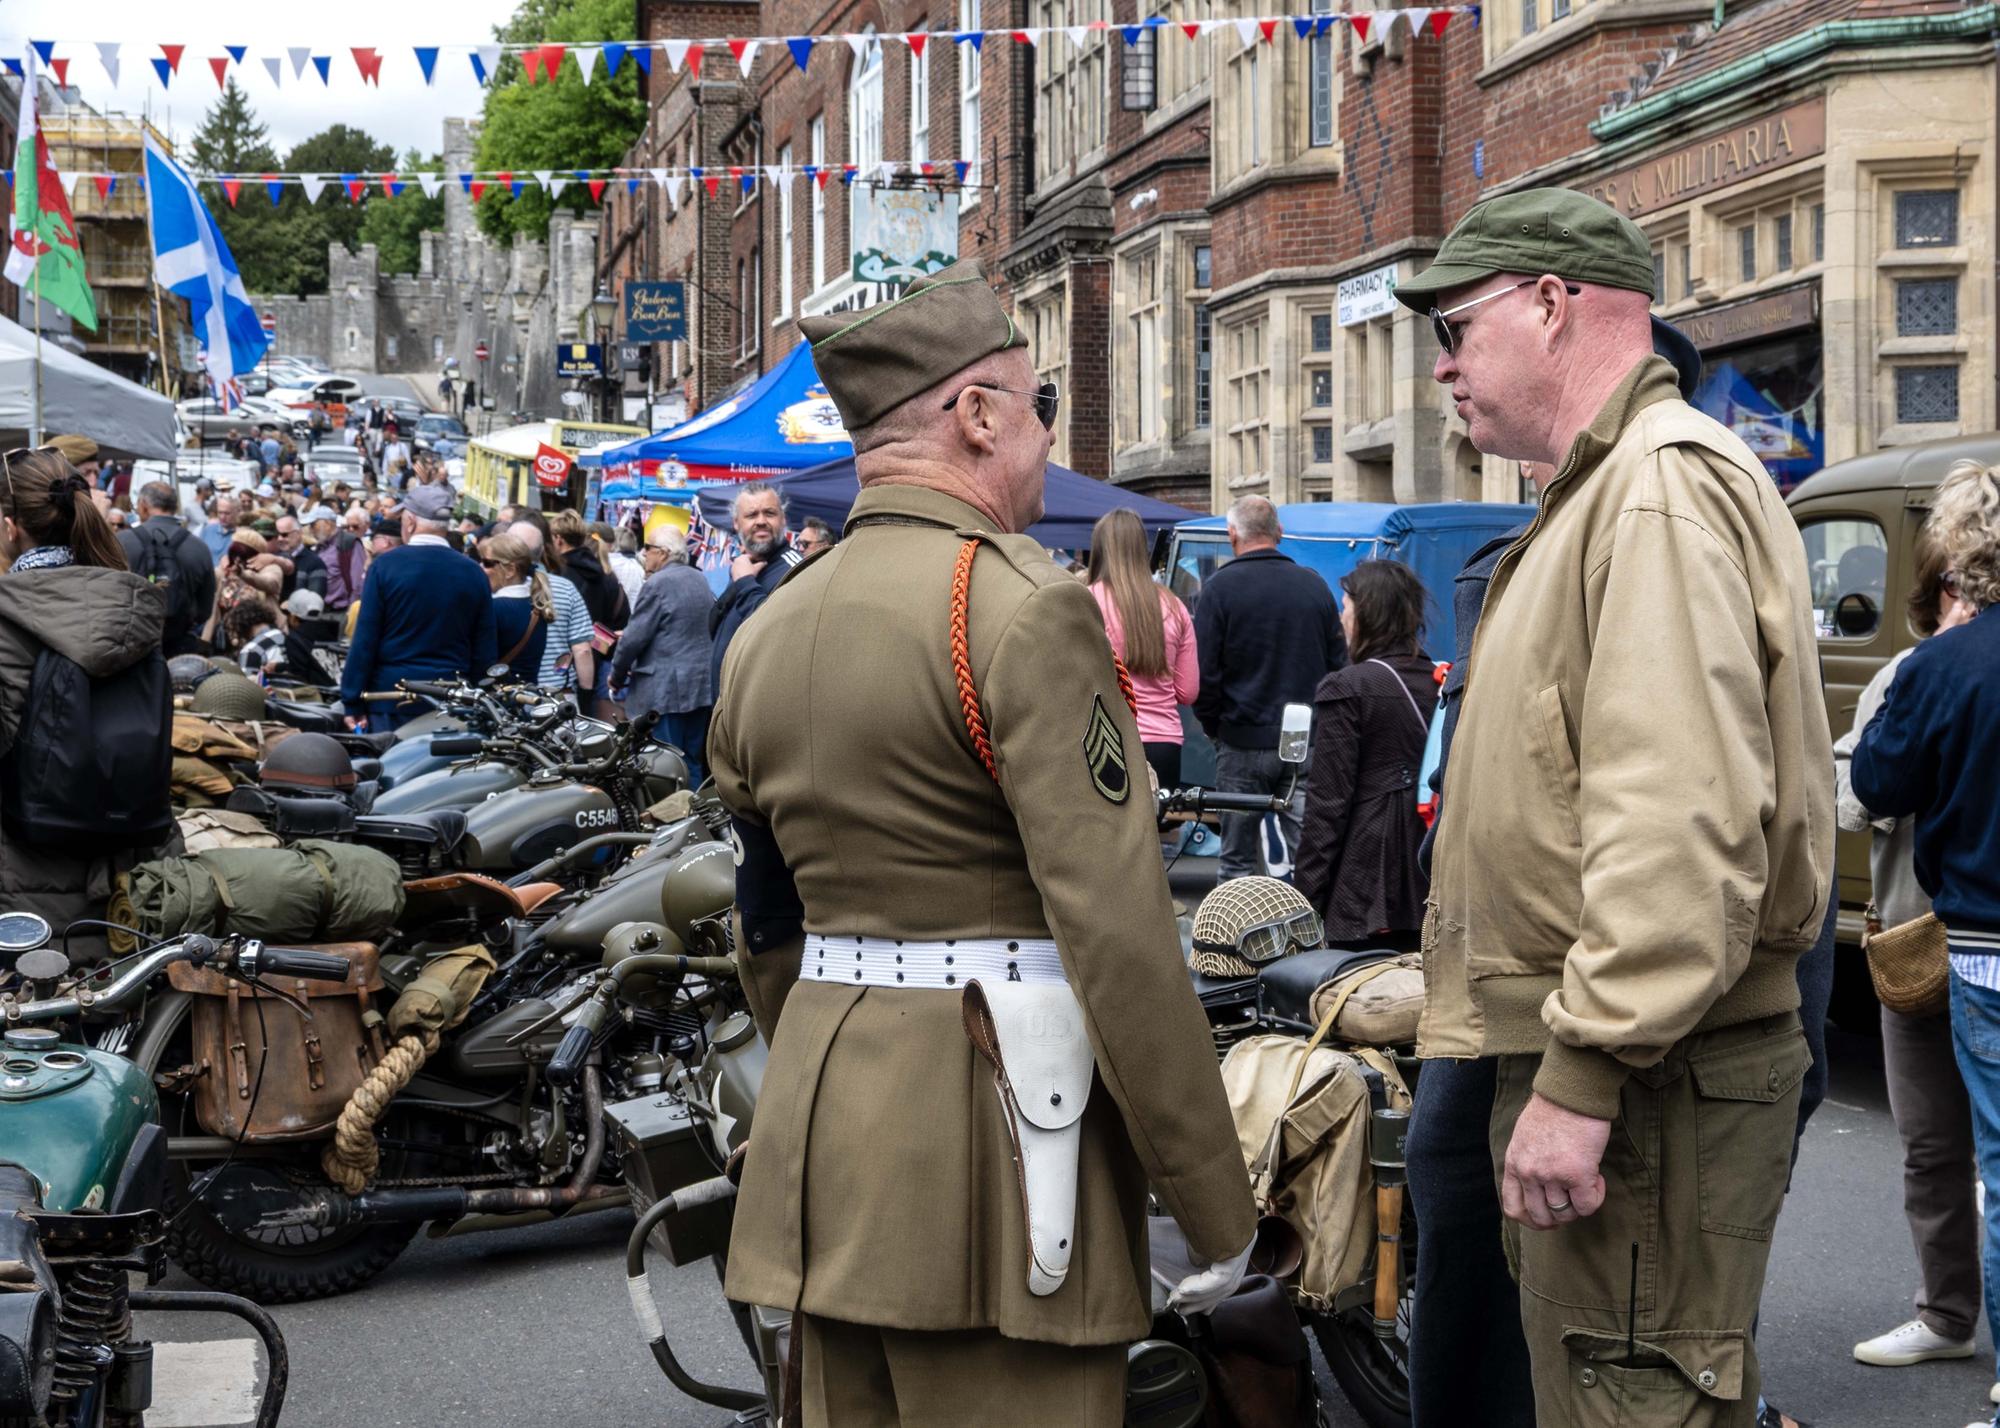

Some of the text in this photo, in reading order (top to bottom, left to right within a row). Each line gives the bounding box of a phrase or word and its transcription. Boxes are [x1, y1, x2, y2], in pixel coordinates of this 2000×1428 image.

[1628, 168, 1643, 212] &
[1655, 116, 1793, 202] MILITARIA
[1340, 271, 1384, 302] PHARMACY
[699, 474, 736, 487] Armed
